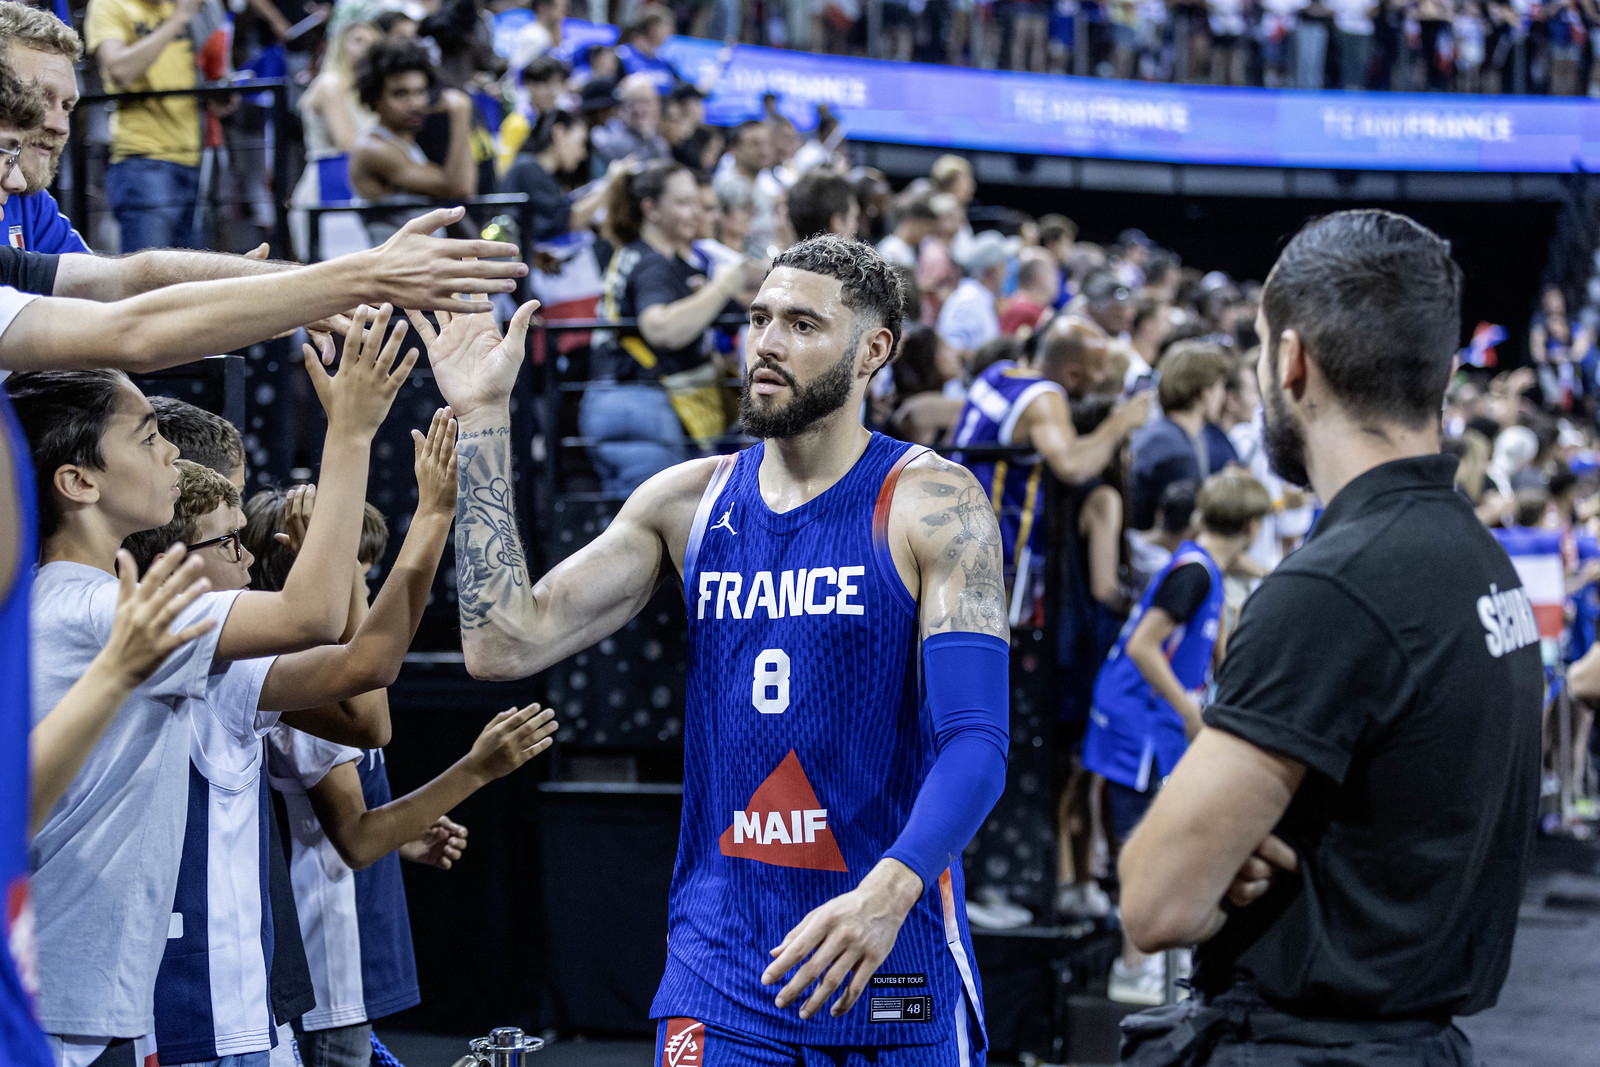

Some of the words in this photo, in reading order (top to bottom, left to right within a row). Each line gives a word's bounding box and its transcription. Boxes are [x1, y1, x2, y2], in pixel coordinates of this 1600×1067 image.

[697, 565, 865, 620] FRANCE
[752, 648, 790, 714] 8
[733, 808, 828, 845] MAIF
[907, 976, 924, 984] TOUS
[906, 1003, 921, 1014] 48
